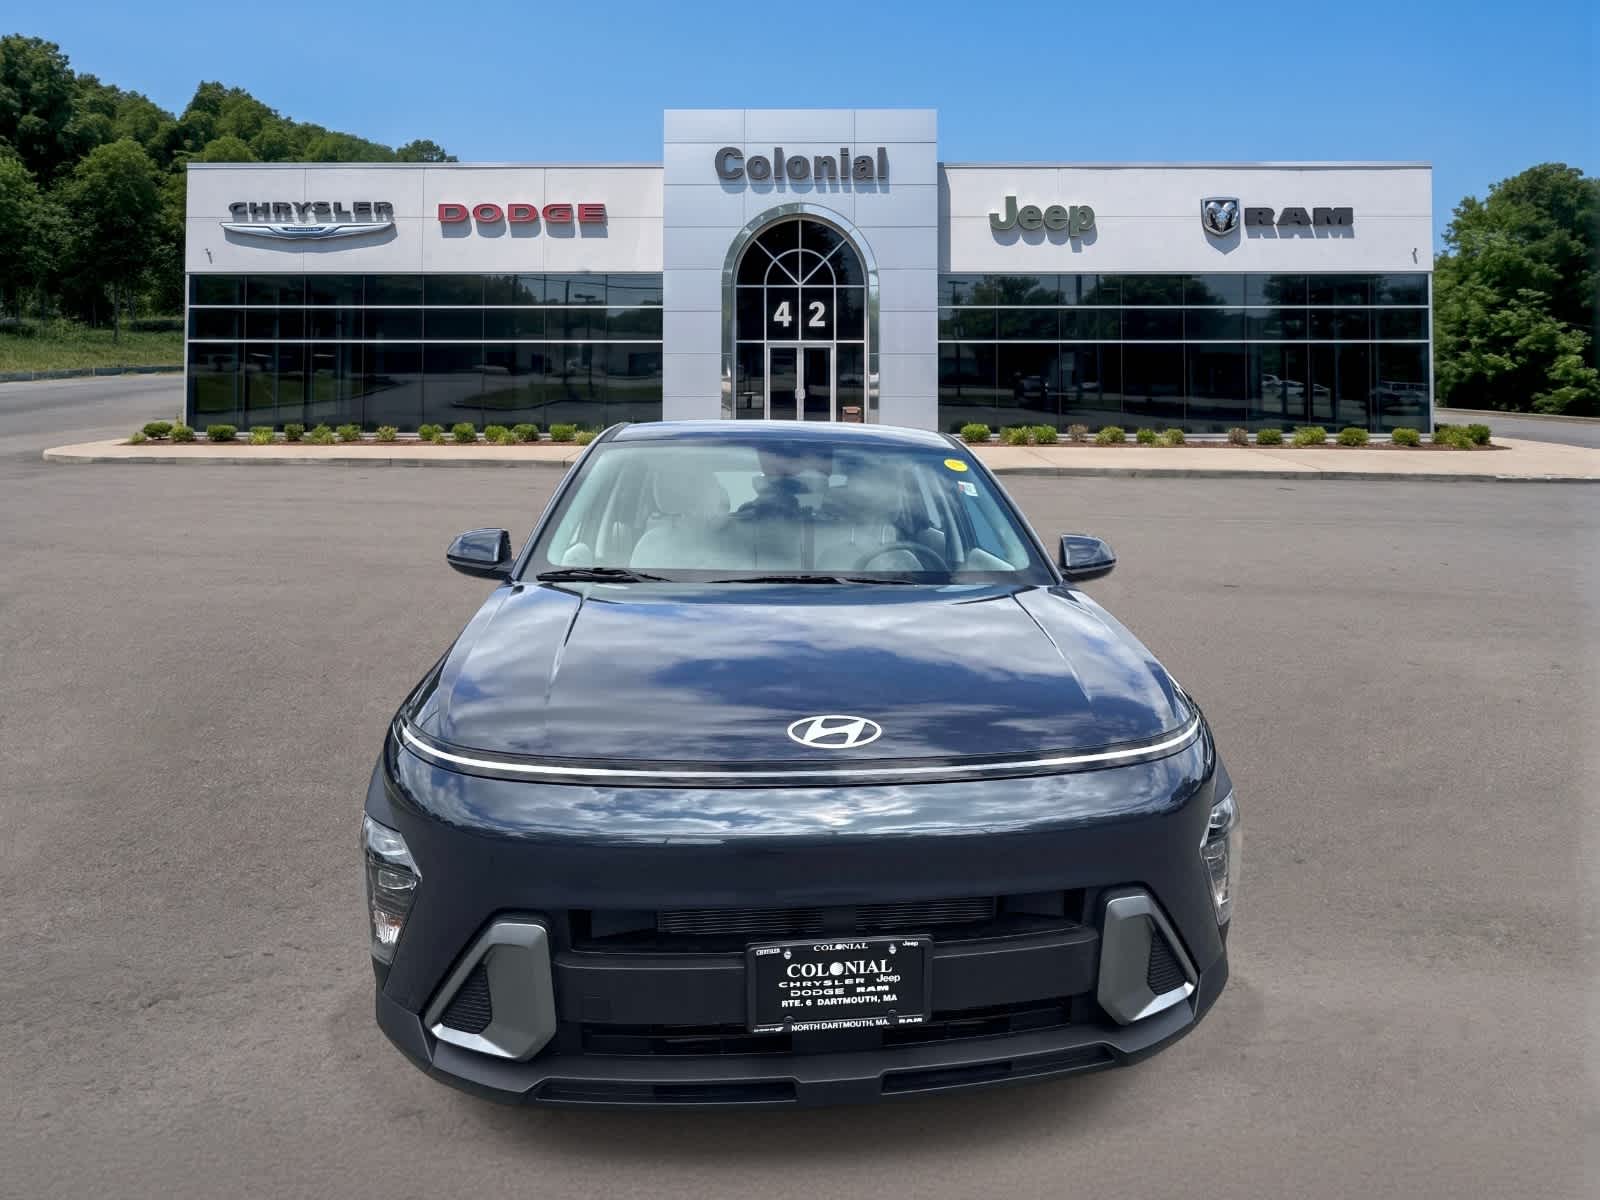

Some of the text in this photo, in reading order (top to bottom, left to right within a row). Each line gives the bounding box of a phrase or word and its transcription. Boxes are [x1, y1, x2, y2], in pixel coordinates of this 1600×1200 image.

[714, 146, 888, 180] Colonial
[228, 201, 394, 216] CHRYSLER
[438, 203, 606, 223] DODGE
[989, 195, 1096, 237] Jeep
[1244, 207, 1354, 227] RAM
[778, 974, 901, 988] CHRYSLER Jeep
[790, 985, 889, 997] DODGE RAM
[781, 1000, 804, 1008] RTE.
[817, 995, 881, 1006] DARTMOUTH,
[883, 994, 898, 1002] MA
[791, 1023, 820, 1032] NORTH
